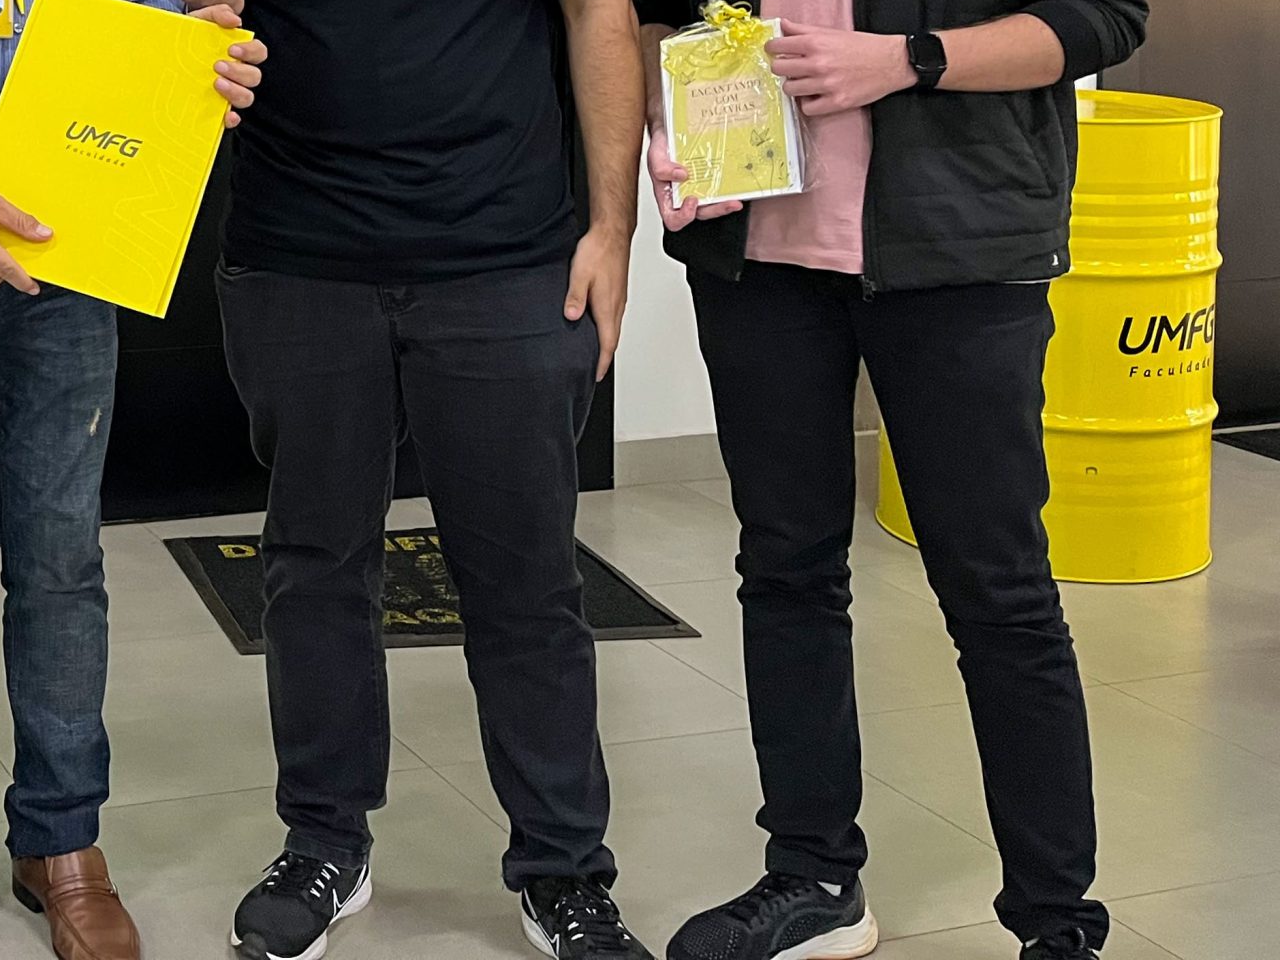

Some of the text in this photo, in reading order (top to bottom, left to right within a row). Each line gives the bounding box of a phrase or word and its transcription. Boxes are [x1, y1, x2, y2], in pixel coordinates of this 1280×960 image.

[691, 79, 762, 98] ENCANTANDO
[715, 93, 739, 104] COM
[701, 101, 756, 118] PALAVRAS
[66, 121, 143, 158] UMFG
[65, 144, 125, 167] Faculdade
[1118, 303, 1216, 355] UMFG
